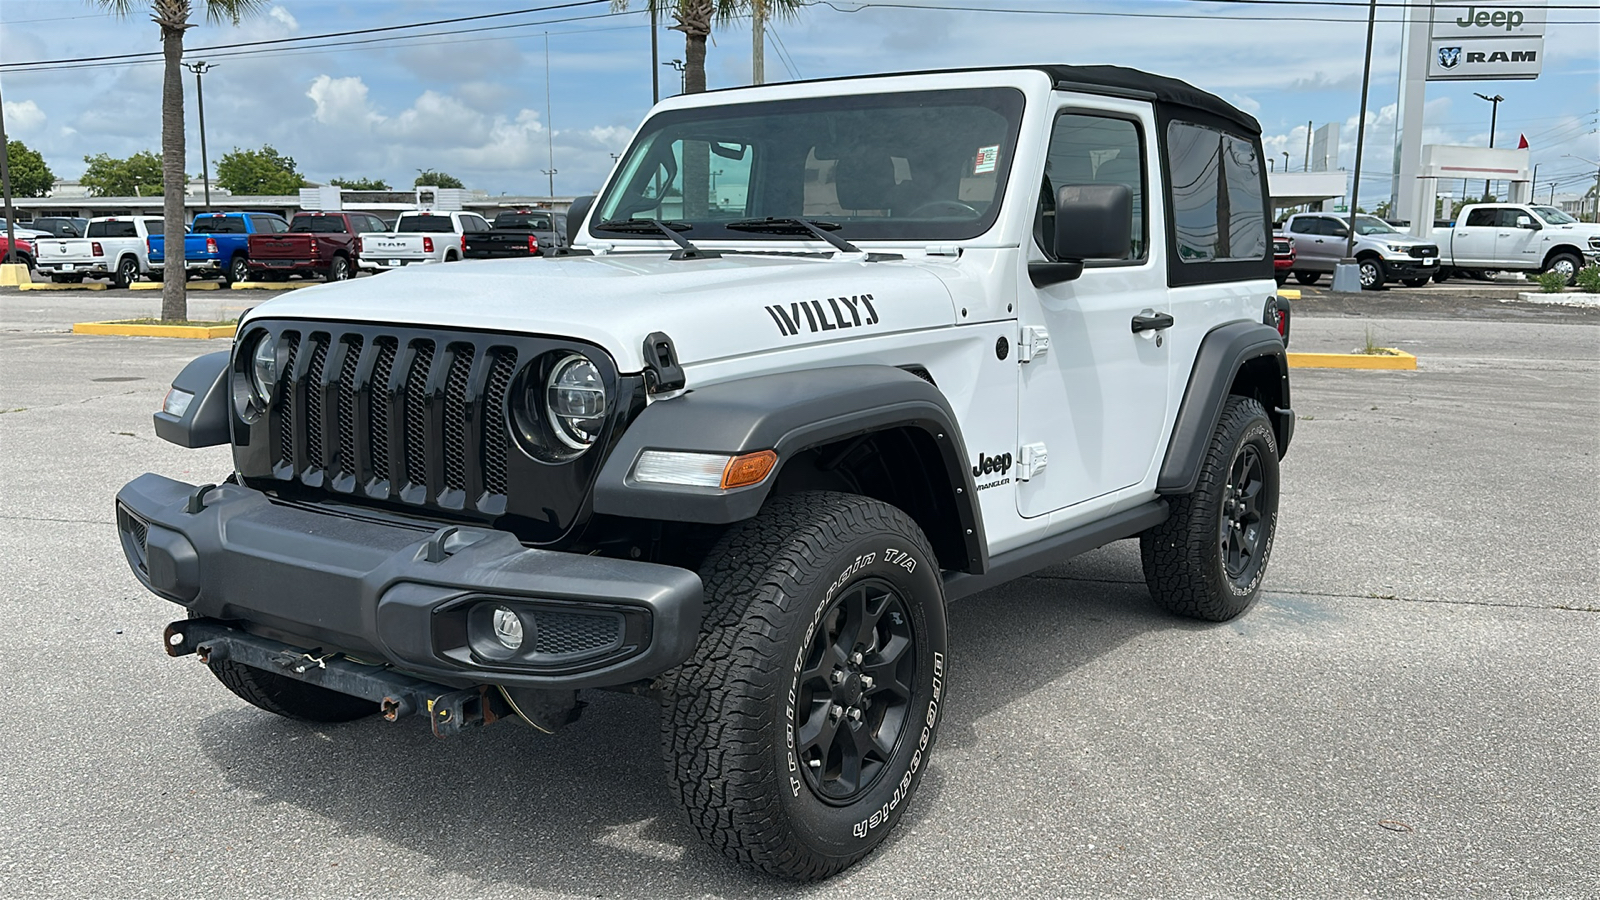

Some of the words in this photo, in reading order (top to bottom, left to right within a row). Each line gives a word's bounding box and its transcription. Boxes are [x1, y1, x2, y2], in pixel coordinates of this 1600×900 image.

[1457, 6, 1524, 31] Jeep
[1466, 51, 1537, 63] RAM
[764, 294, 879, 336] WILLYS
[972, 452, 1012, 477] Jeep
[884, 548, 917, 574] T/A
[853, 652, 943, 838] BFGoodrich
